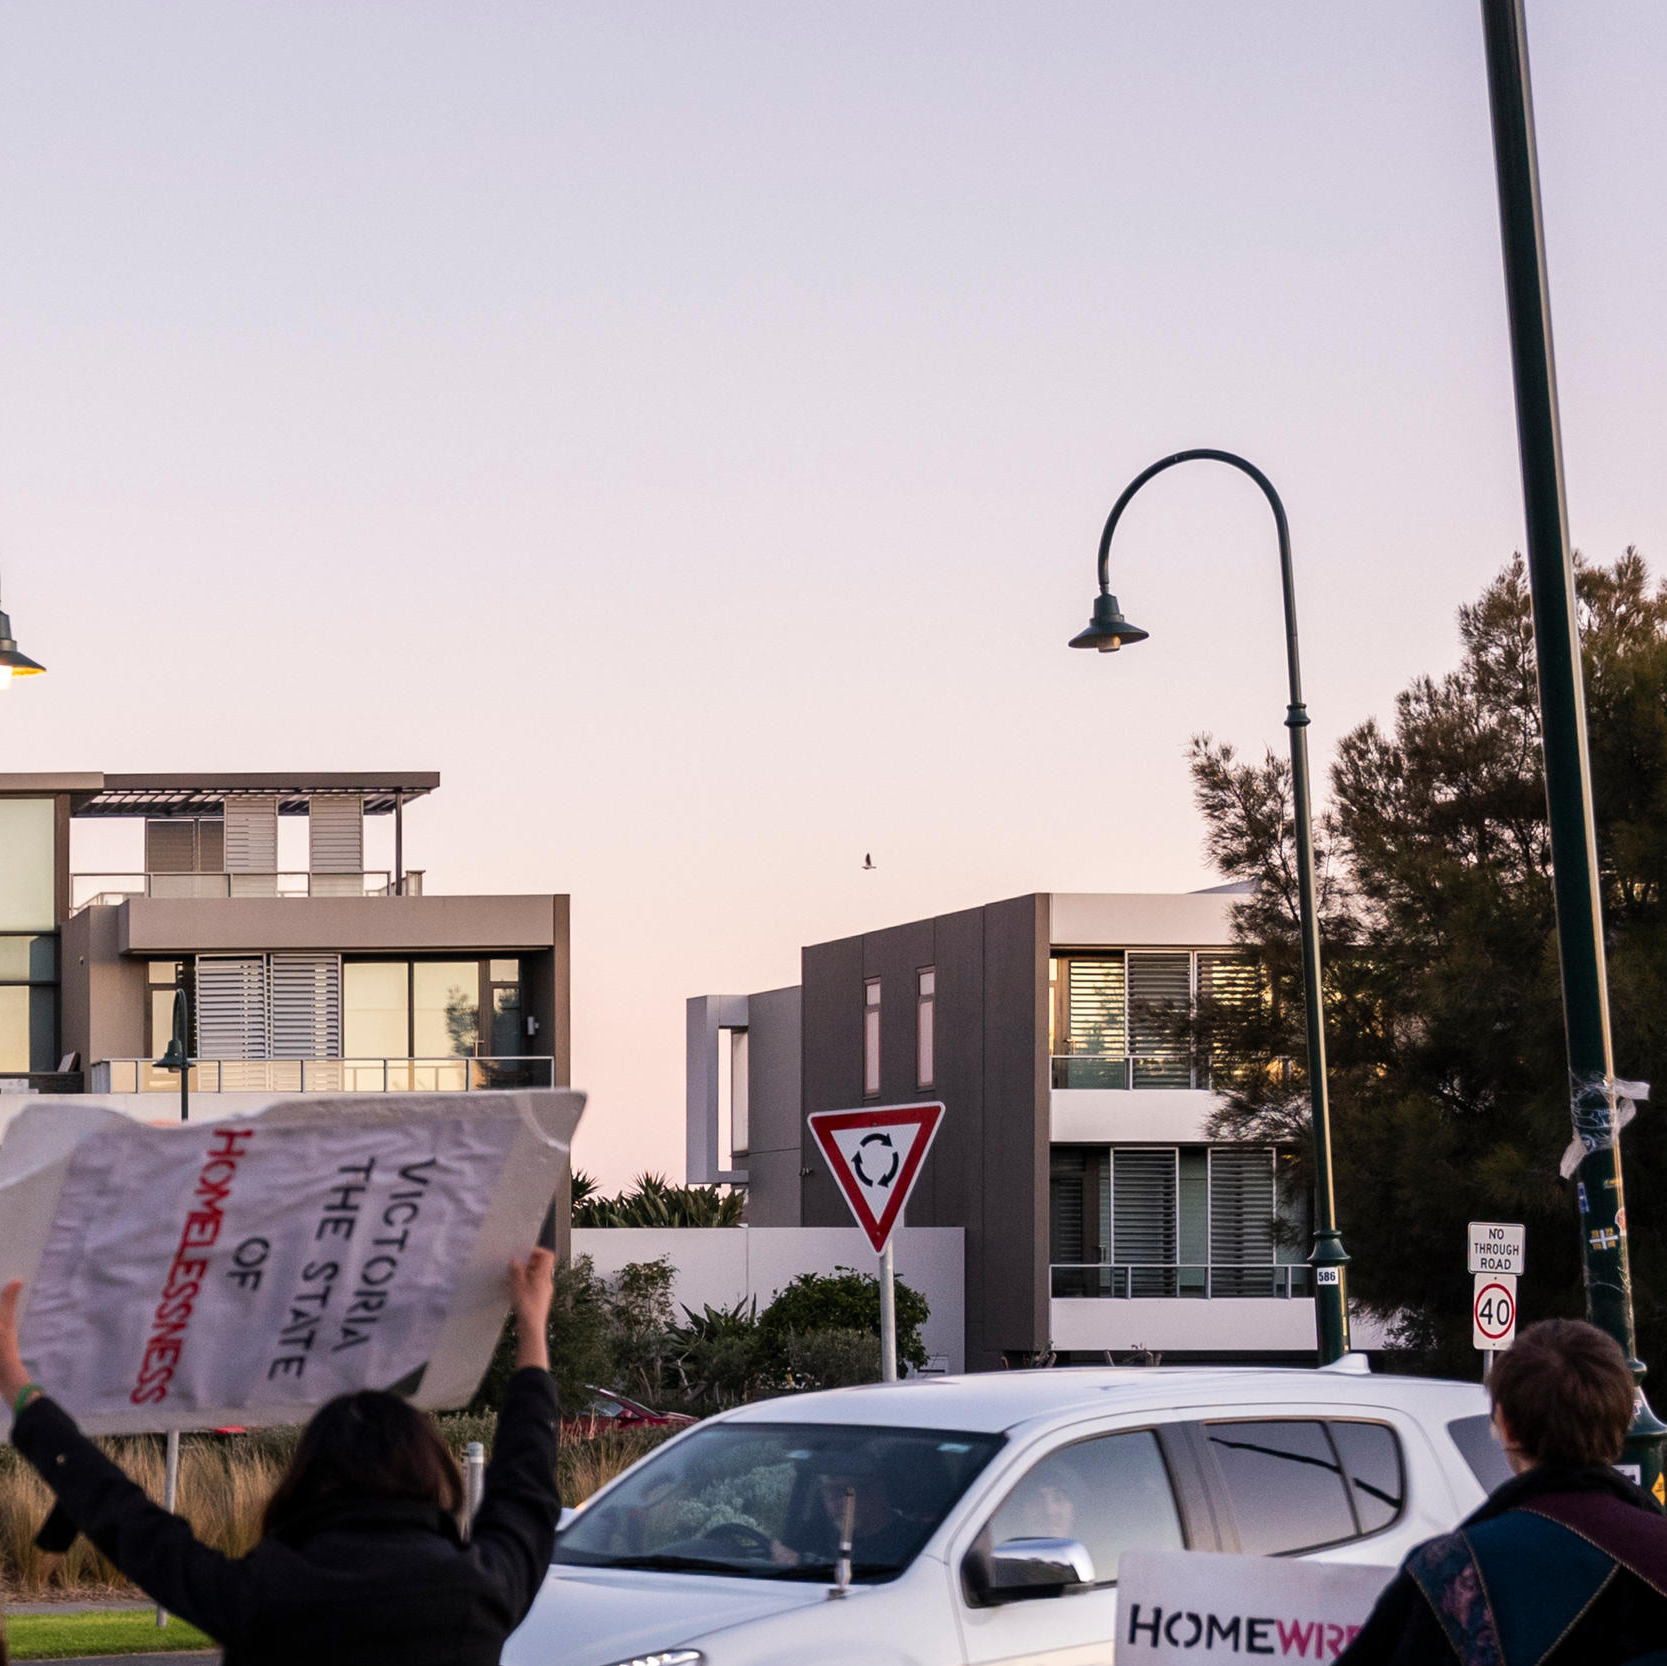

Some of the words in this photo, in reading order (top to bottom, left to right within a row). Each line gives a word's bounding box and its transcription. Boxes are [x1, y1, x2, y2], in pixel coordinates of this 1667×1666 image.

[315, 1156, 377, 1242] THE
[1474, 1242, 1520, 1256] THROUGH
[1488, 1227, 1505, 1240] NO
[129, 1128, 255, 1405] HOMELESSNESS
[226, 1236, 271, 1292] OF
[331, 1157, 437, 1354] VICTORIA
[1318, 1271, 1336, 1282] 586
[1480, 1257, 1512, 1270] ROAD
[268, 1260, 340, 1380] STATE
[1478, 1297, 1511, 1326] 40
